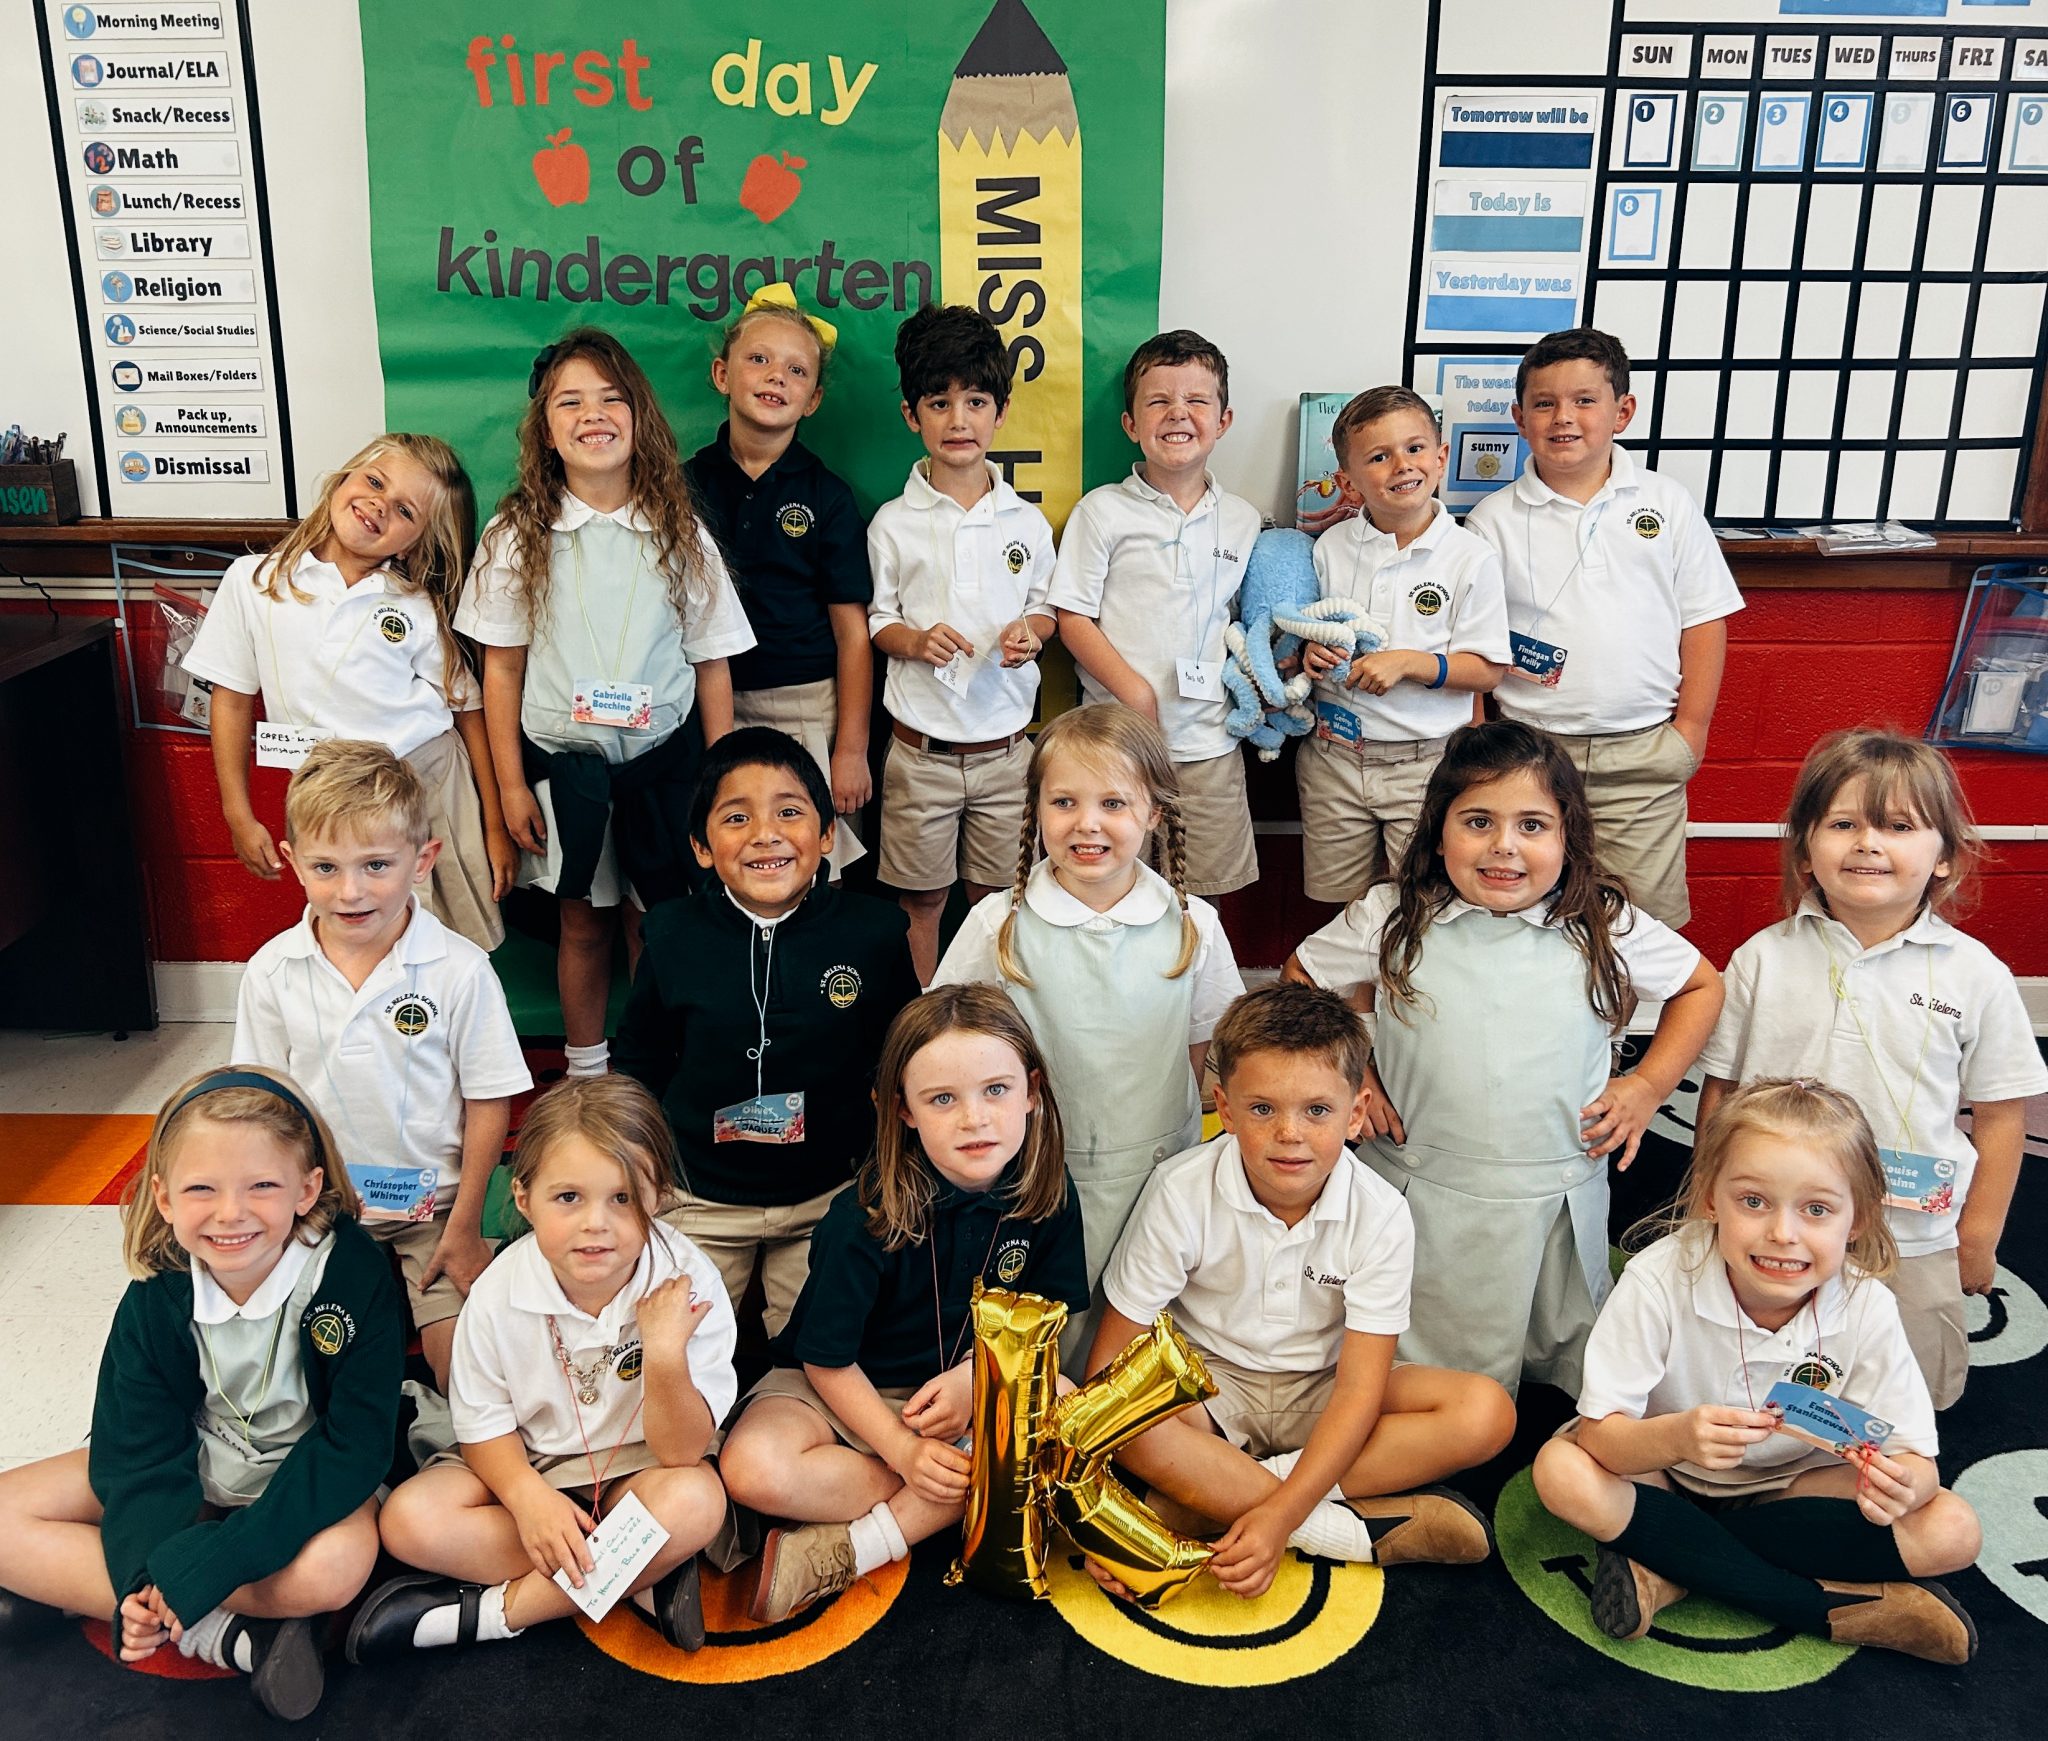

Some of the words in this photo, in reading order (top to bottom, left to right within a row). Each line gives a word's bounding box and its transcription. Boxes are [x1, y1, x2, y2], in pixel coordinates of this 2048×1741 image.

[97, 14, 157, 30] Morning
[161, 14, 220, 30] Meeting
[1632, 45, 1673, 64] SUN
[1707, 49, 1748, 65] MON
[1771, 47, 1813, 64] TUES
[1834, 47, 1875, 64] WED
[1895, 50, 1937, 63] THURS
[1958, 47, 1995, 66] FRI
[106, 60, 219, 80] Journal/ELA
[466, 35, 653, 110] first
[711, 38, 879, 125] day
[112, 106, 231, 124] Snack/Recess
[1451, 106, 1533, 123] Tomorrow
[1537, 108, 1566, 124] will
[1569, 108, 1589, 124] be
[1640, 105, 1650, 119] 1
[1709, 107, 1719, 121] 2
[1772, 108, 1782, 122] 3
[1834, 105, 1845, 119] 4
[1956, 104, 1966, 118] 6
[2028, 107, 2038, 122] 7
[117, 148, 179, 169] Math
[617, 135, 705, 205] of
[122, 192, 241, 211] Lunch/Recess
[1469, 192, 1530, 215] Today
[1534, 194, 1551, 211] is
[1624, 199, 1635, 213] 8
[131, 232, 213, 256] Library
[437, 226, 933, 321] kindergarten
[134, 277, 222, 301] Religion
[1436, 271, 1532, 295] Yesterday
[1535, 276, 1572, 292] was
[139, 324, 214, 337] Science/Social
[216, 324, 255, 336] Studies
[147, 370, 173, 382] Mail
[175, 369, 257, 382] Boxes/Folders
[1454, 374, 1480, 390] The
[1483, 376, 1517, 389] weat
[1317, 401, 1338, 416] The
[1467, 398, 1510, 415] today
[177, 409, 208, 421] Pack
[209, 410, 232, 424] up,
[155, 421, 258, 435] Announcements
[1470, 442, 1511, 455] sunny
[155, 457, 251, 476] Dismissal
[1518, 644, 1550, 661] Finnegan
[1521, 655, 1542, 669] Reilly
[593, 690, 632, 702] Gabriella
[592, 699, 631, 711] Bocchino
[260, 732, 290, 742] CARES
[391, 992, 420, 1006] HELENA
[1909, 993, 1924, 1007] St.
[1928, 998, 1962, 1019] Helena
[363, 1179, 418, 1192] Christopher
[370, 1190, 410, 1202] Whitney
[1318, 1274, 1347, 1286] Helen
[314, 1303, 345, 1316] HELENA
[1820, 1355, 1844, 1378] SCHOOL
[1808, 1401, 1840, 1420] Emma
